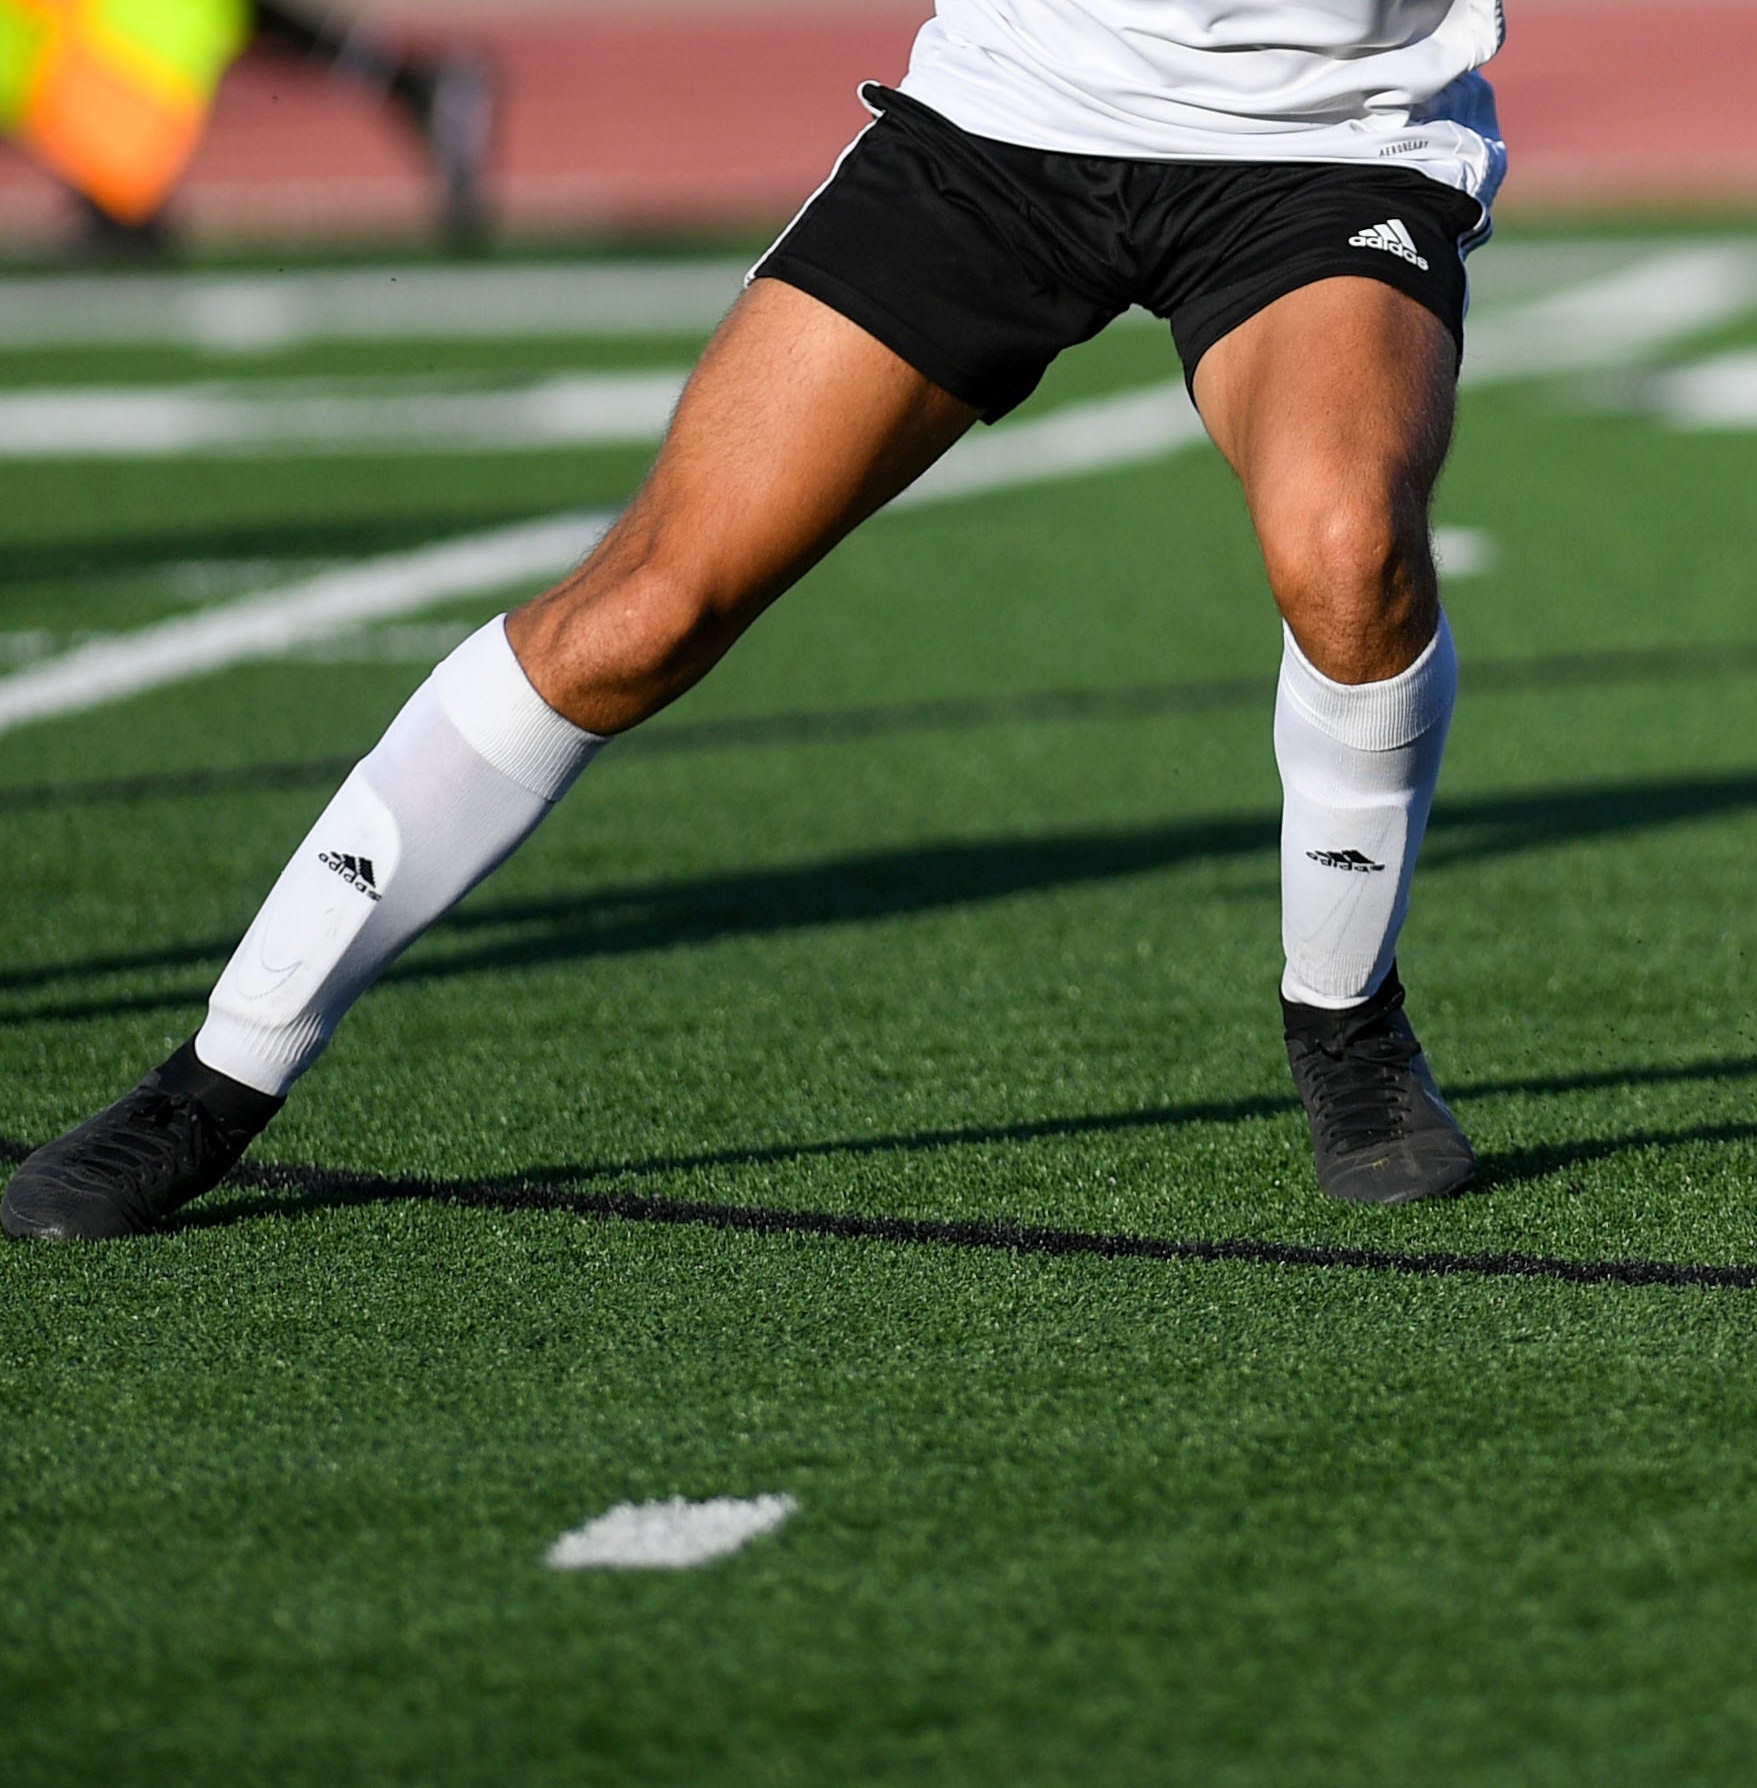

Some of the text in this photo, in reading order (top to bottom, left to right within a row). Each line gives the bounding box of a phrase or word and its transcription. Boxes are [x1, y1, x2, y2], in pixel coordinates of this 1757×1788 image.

[1348, 235, 1429, 271] adidas
[318, 852, 382, 901] adidas
[1306, 851, 1385, 874] adidas
